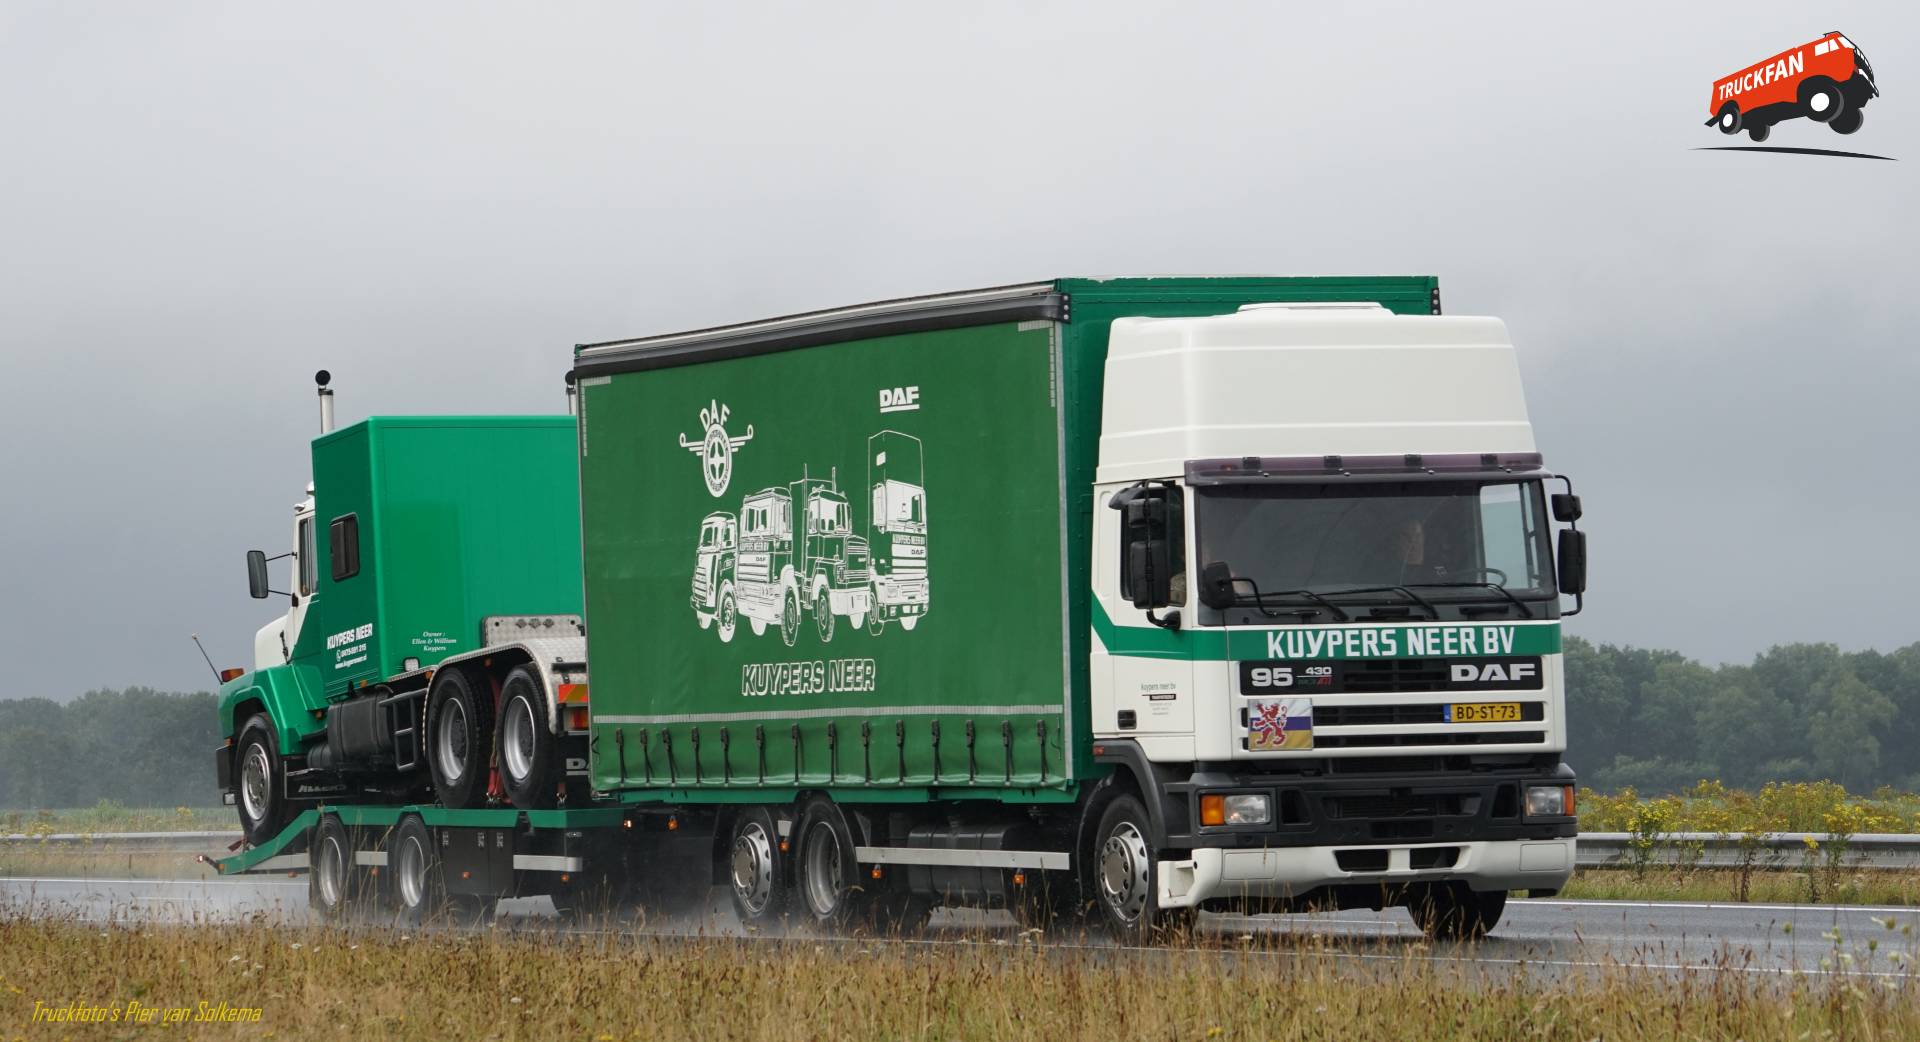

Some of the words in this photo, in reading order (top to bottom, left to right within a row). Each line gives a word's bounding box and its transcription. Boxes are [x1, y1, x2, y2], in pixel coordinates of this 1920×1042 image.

[880, 386, 920, 407] DAF
[700, 399, 731, 432] DAF
[327, 628, 355, 650] KUYPERS
[356, 622, 373, 641] NEER
[1267, 628, 1397, 658] KUYPERS
[1407, 626, 1475, 656] NEER
[1483, 626, 1515, 654] BV
[423, 645, 447, 653] Kuypers
[741, 660, 825, 696] KUYPERS
[828, 658, 876, 692] NEER
[1251, 667, 1293, 687] 95
[1305, 667, 1333, 675] 430
[1450, 663, 1536, 682] DAF
[1456, 704, 1516, 720] BD-ST-73
